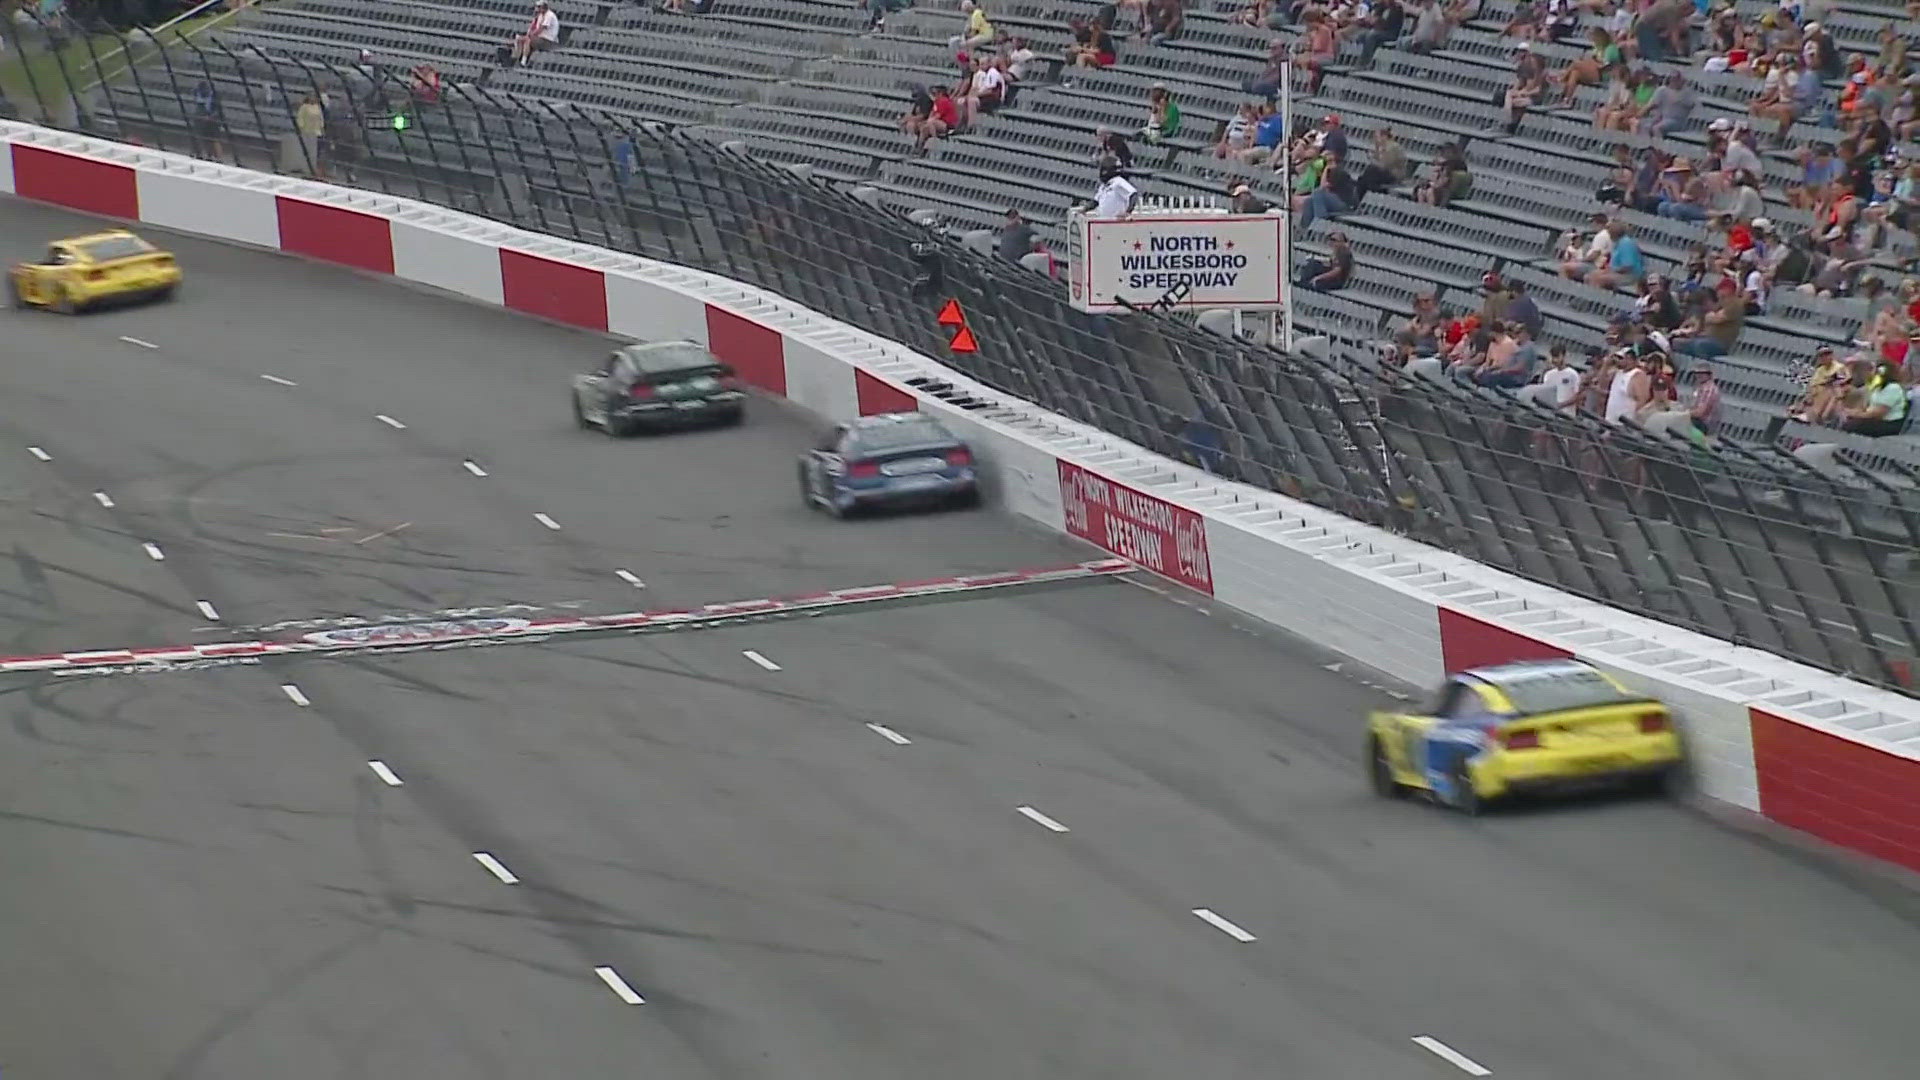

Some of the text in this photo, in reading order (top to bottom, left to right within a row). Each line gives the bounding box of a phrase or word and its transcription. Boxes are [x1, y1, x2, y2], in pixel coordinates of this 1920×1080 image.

[1150, 236, 1217, 251] NORTH
[1121, 254, 1247, 270] WILKESBORO
[1129, 272, 1238, 288] SPEEDWAY
[1114, 487, 1174, 536] WILKESBORO
[1104, 513, 1164, 572] SPEEDWAY
